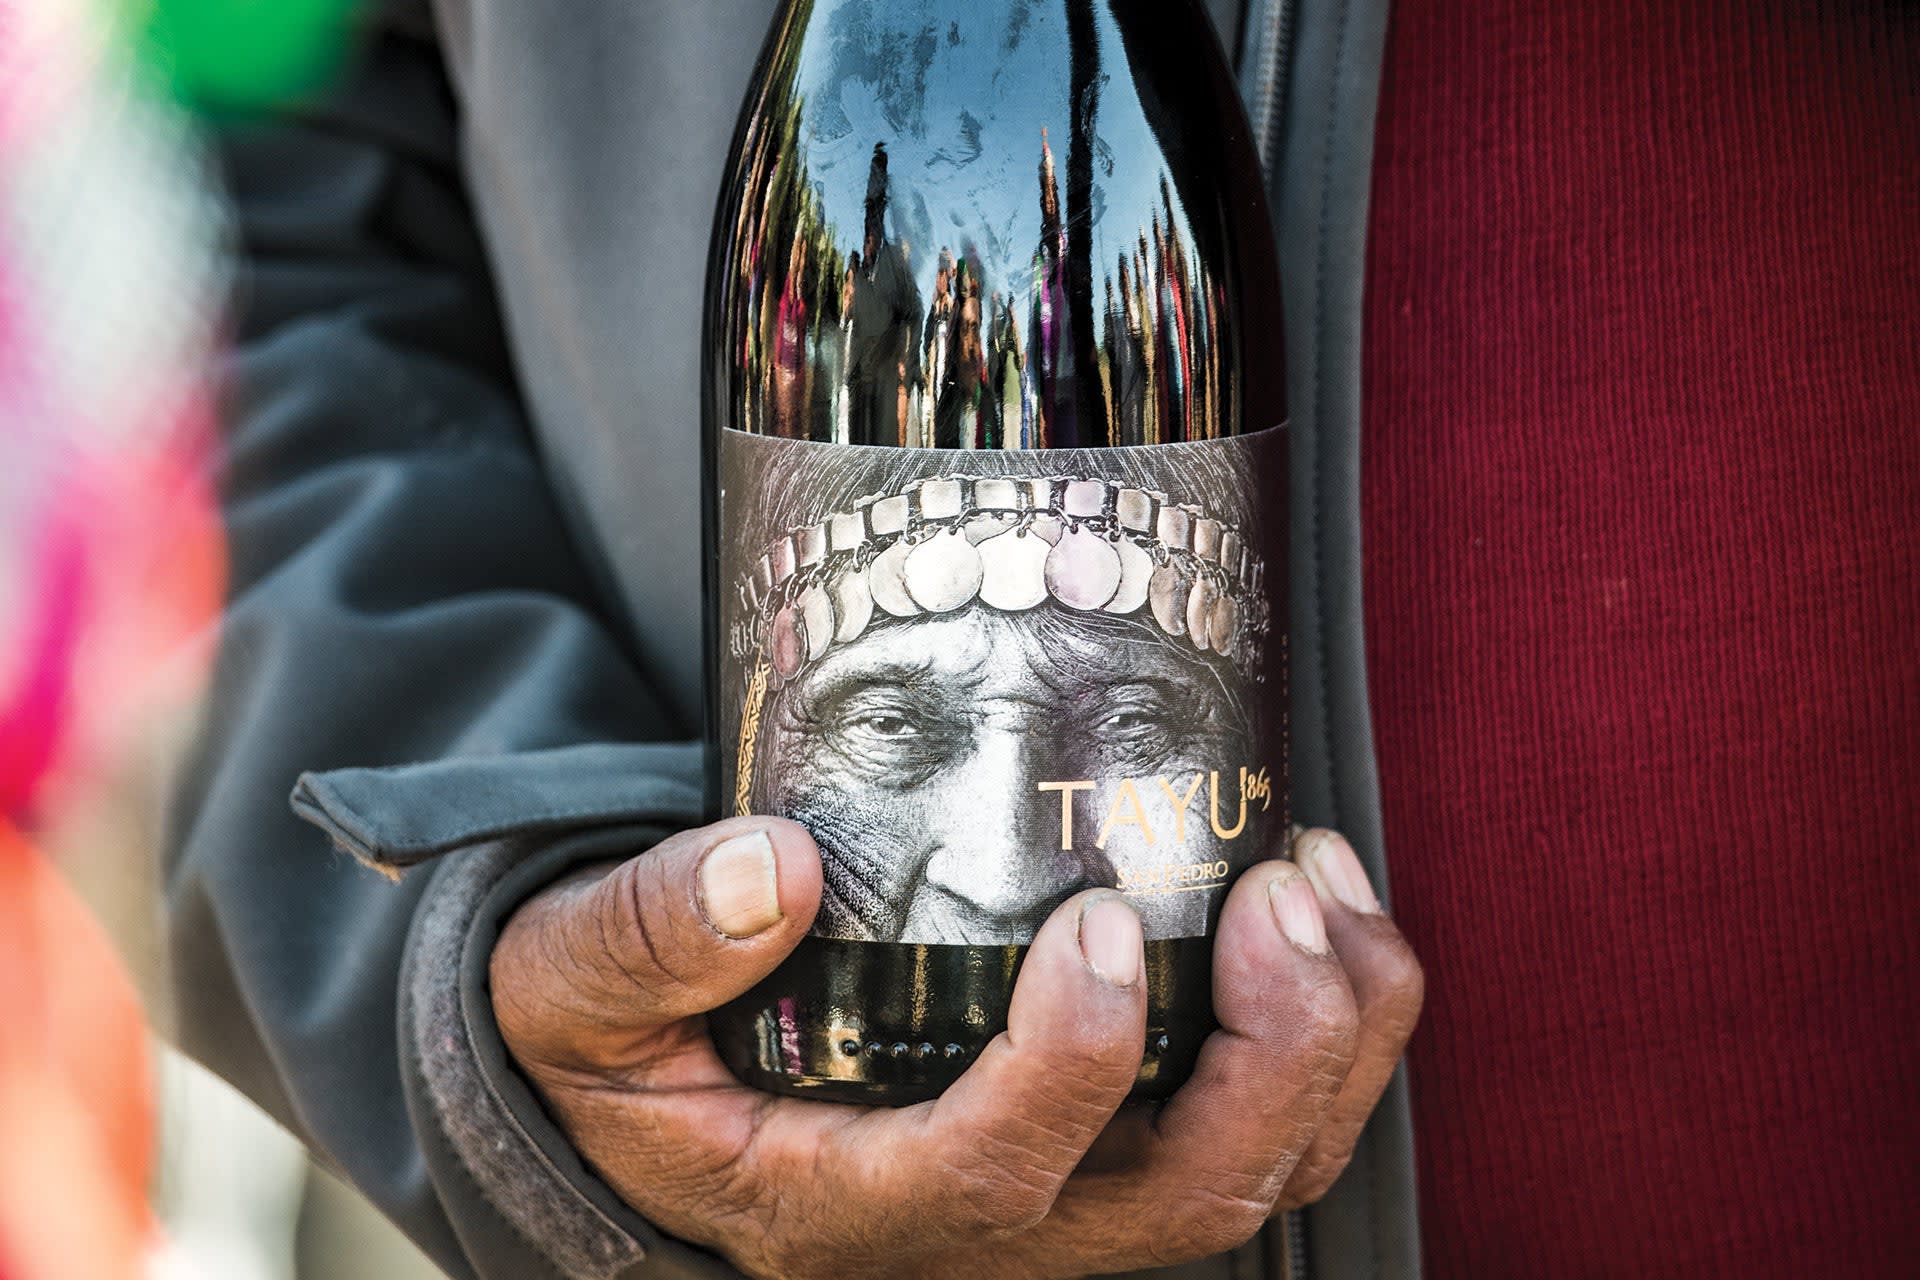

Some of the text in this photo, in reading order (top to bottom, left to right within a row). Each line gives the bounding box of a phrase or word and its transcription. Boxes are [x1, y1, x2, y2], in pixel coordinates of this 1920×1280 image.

[1038, 766, 1271, 850] TAYU 1865
[1163, 861, 1229, 884] PEDRO
